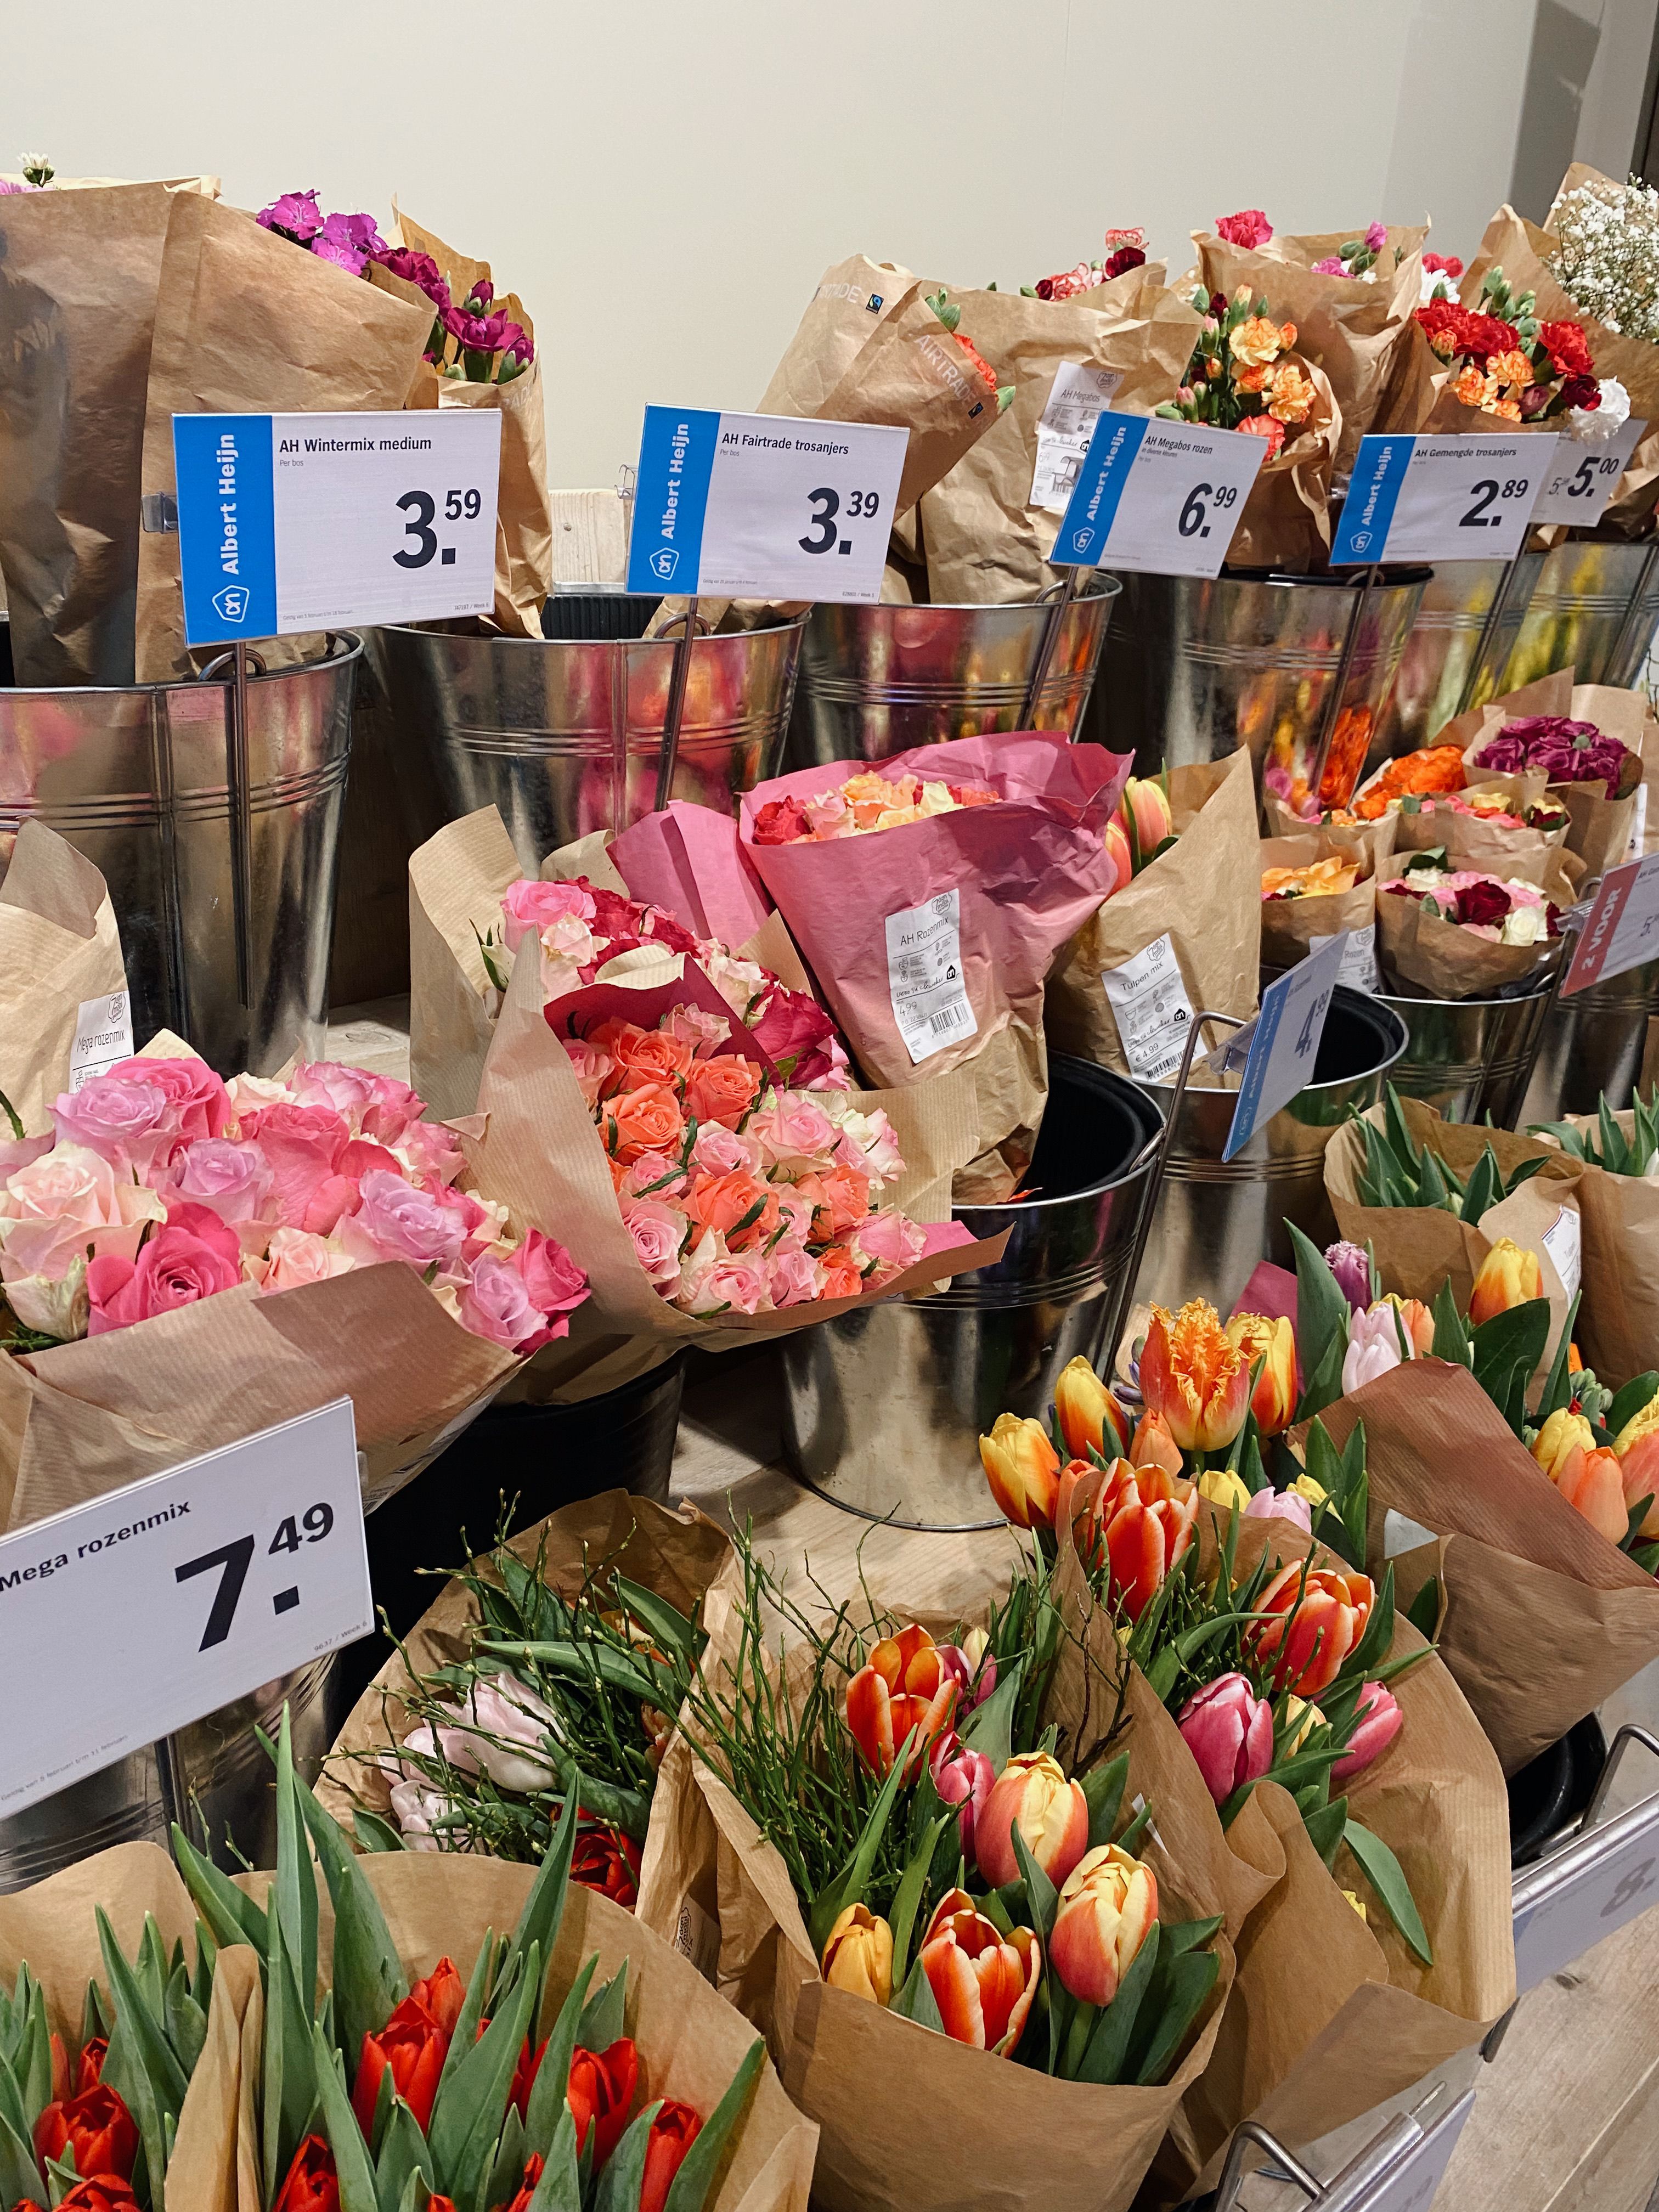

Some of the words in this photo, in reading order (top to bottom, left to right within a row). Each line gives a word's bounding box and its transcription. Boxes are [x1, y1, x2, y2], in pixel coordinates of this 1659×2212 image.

[1061, 390, 1072, 398] AH
[1073, 390, 1101, 403] Megabos
[279, 439, 299, 453] AH
[304, 438, 375, 452] Wintermix
[379, 437, 431, 450] medium
[669, 424, 690, 473] Heijn
[722, 433, 738, 445] AH
[742, 435, 792, 450] Fairtrade
[795, 439, 849, 455] trosanjers
[1144, 436, 1156, 445] AH
[1158, 438, 1190, 452] Megabos
[1192, 445, 1213, 455] rozen
[1415, 448, 1427, 458] AH
[1429, 448, 1474, 459] Gemengde
[1476, 447, 1517, 459] trosanjers
[217, 434, 239, 494] Heijn
[1087, 471, 1109, 521] Albert
[1103, 427, 1126, 467] Heijn
[1362, 484, 1380, 526] Albert
[1374, 446, 1392, 481] Heijn
[661, 479, 680, 539] Albert
[221, 502, 239, 575] Albert
[901, 934, 914, 946] AH
[917, 917, 949, 941] Rozenmix
[1588, 887, 1622, 951] VOOR
[1120, 972, 1149, 991] Tulpen
[1150, 961, 1163, 974] mix
[77, 1036, 93, 1054] Mega
[94, 1028, 125, 1047] rozenmix
[1143, 1043, 1159, 1058] 4.99
[0, 1553, 68, 1592] Mega
[77, 1500, 191, 1559] rozenmix
[341, 1624, 360, 1638] Week
